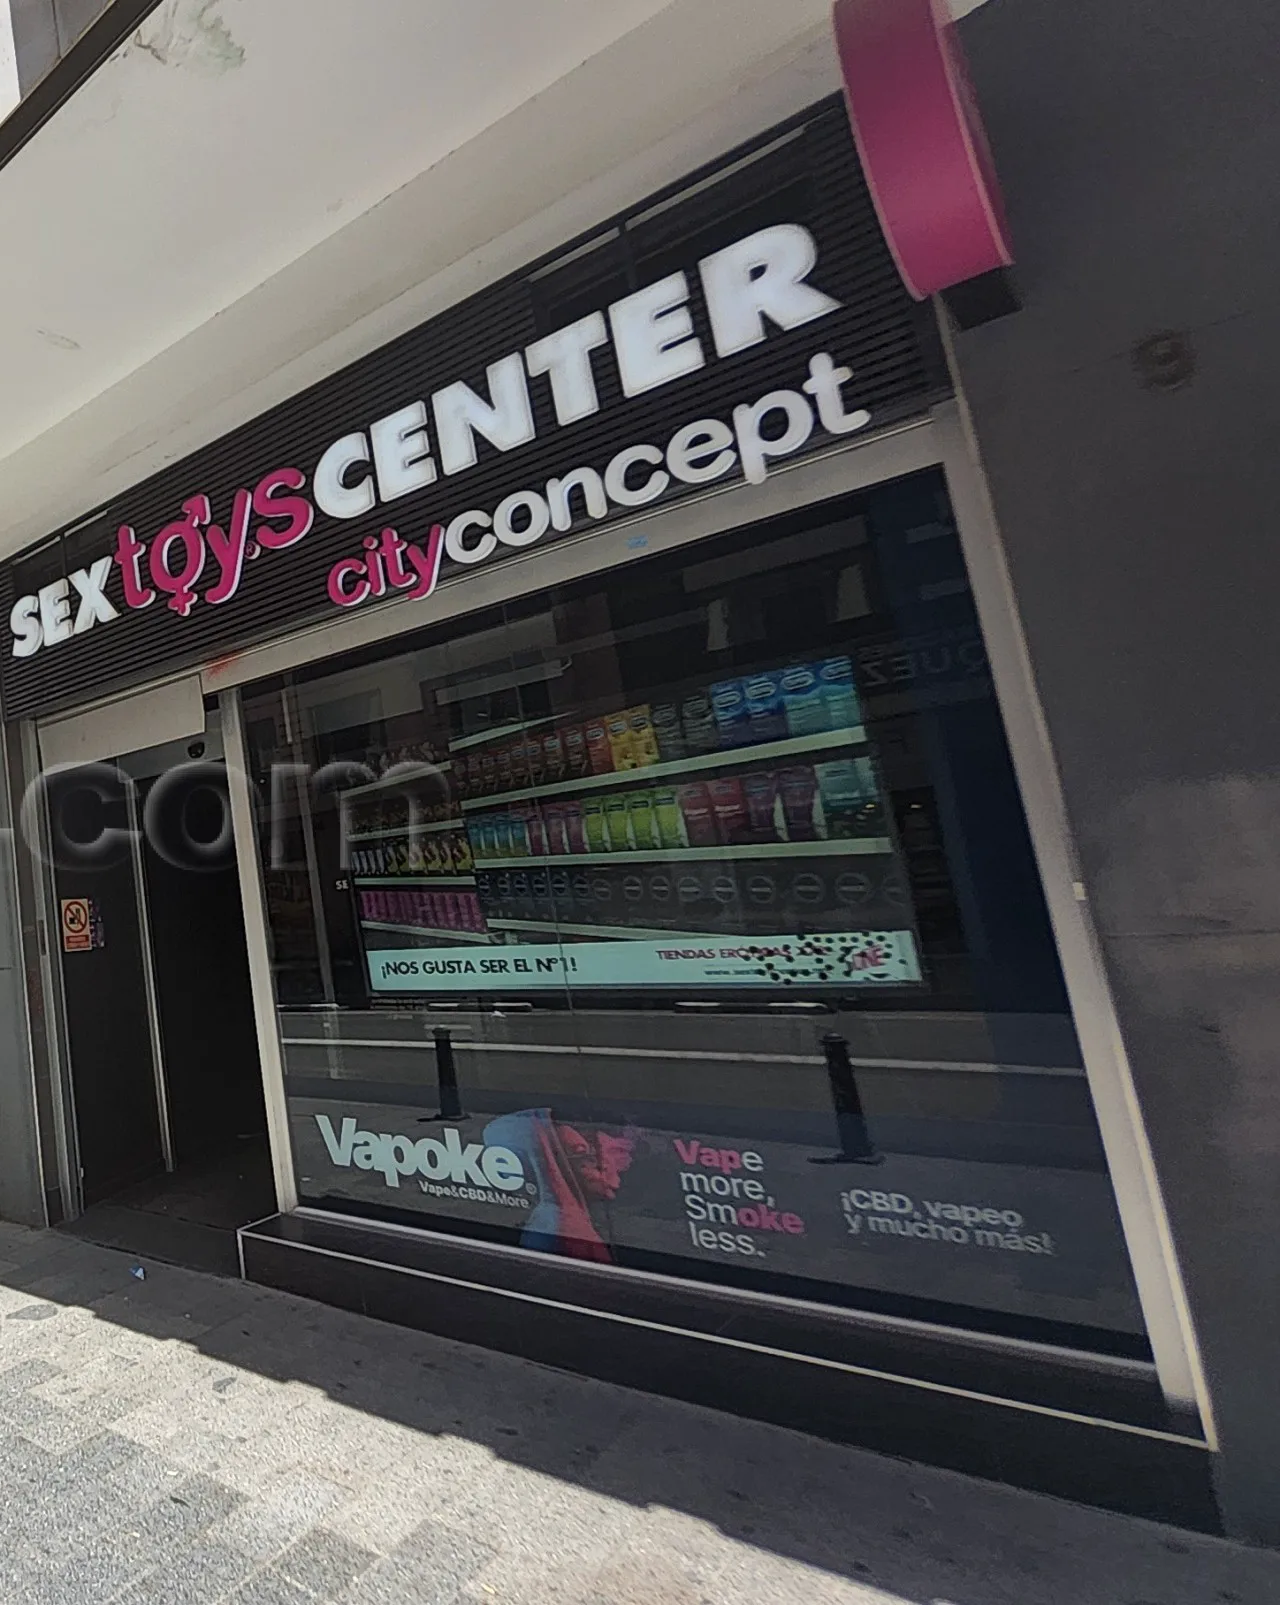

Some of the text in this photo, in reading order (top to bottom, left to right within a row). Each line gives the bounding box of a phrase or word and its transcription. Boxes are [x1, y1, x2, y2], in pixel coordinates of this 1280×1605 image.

[381, 961, 418, 979] ¡NOS
[422, 960, 476, 974] GUSTA
[480, 959, 510, 973] SER
[514, 958, 532, 973] EL
[656, 949, 715, 960] TIENDAS
[315, 1114, 525, 1191] Vapoke
[673, 1139, 764, 1174] Vape
[680, 1171, 776, 1208] more,
[685, 1194, 805, 1234] Smoke
[844, 1213, 862, 1234] y
[867, 1215, 970, 1244] mucho
[923, 1200, 1024, 1227] vapeo
[688, 1220, 767, 1257] less.
